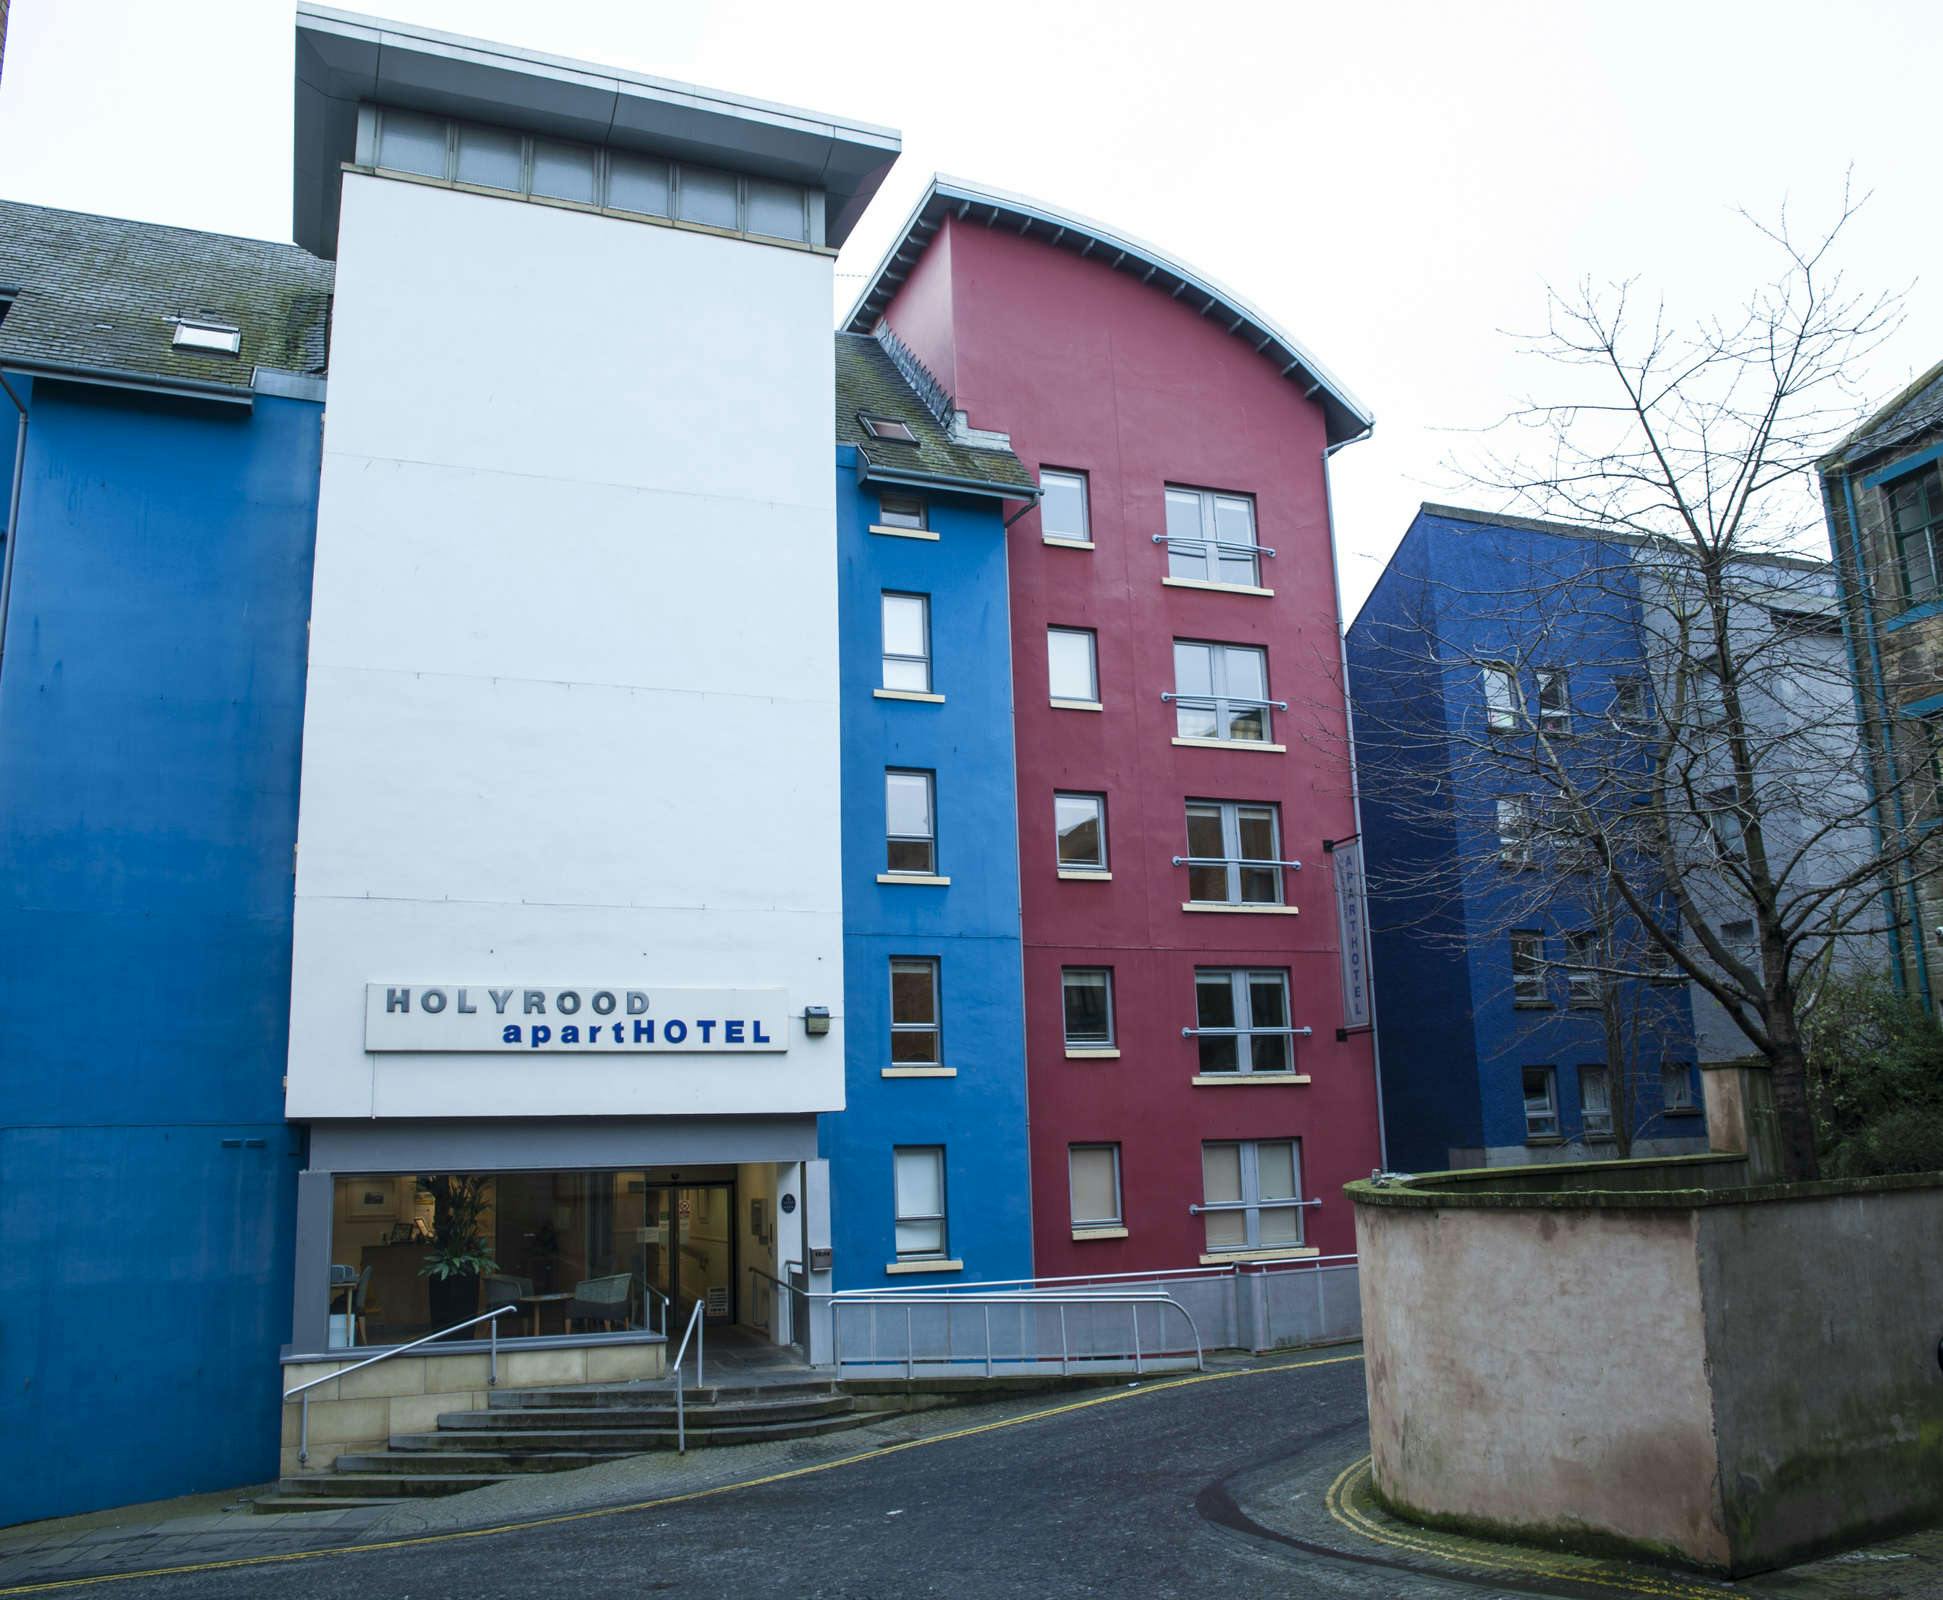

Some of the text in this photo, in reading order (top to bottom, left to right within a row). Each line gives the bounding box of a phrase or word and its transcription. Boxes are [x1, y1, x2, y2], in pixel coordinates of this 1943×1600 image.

[1345, 855, 1362, 1015] APARTHOTEL
[385, 987, 651, 1015] HOLYROOD
[502, 1019, 771, 1047] apartHOTEL
